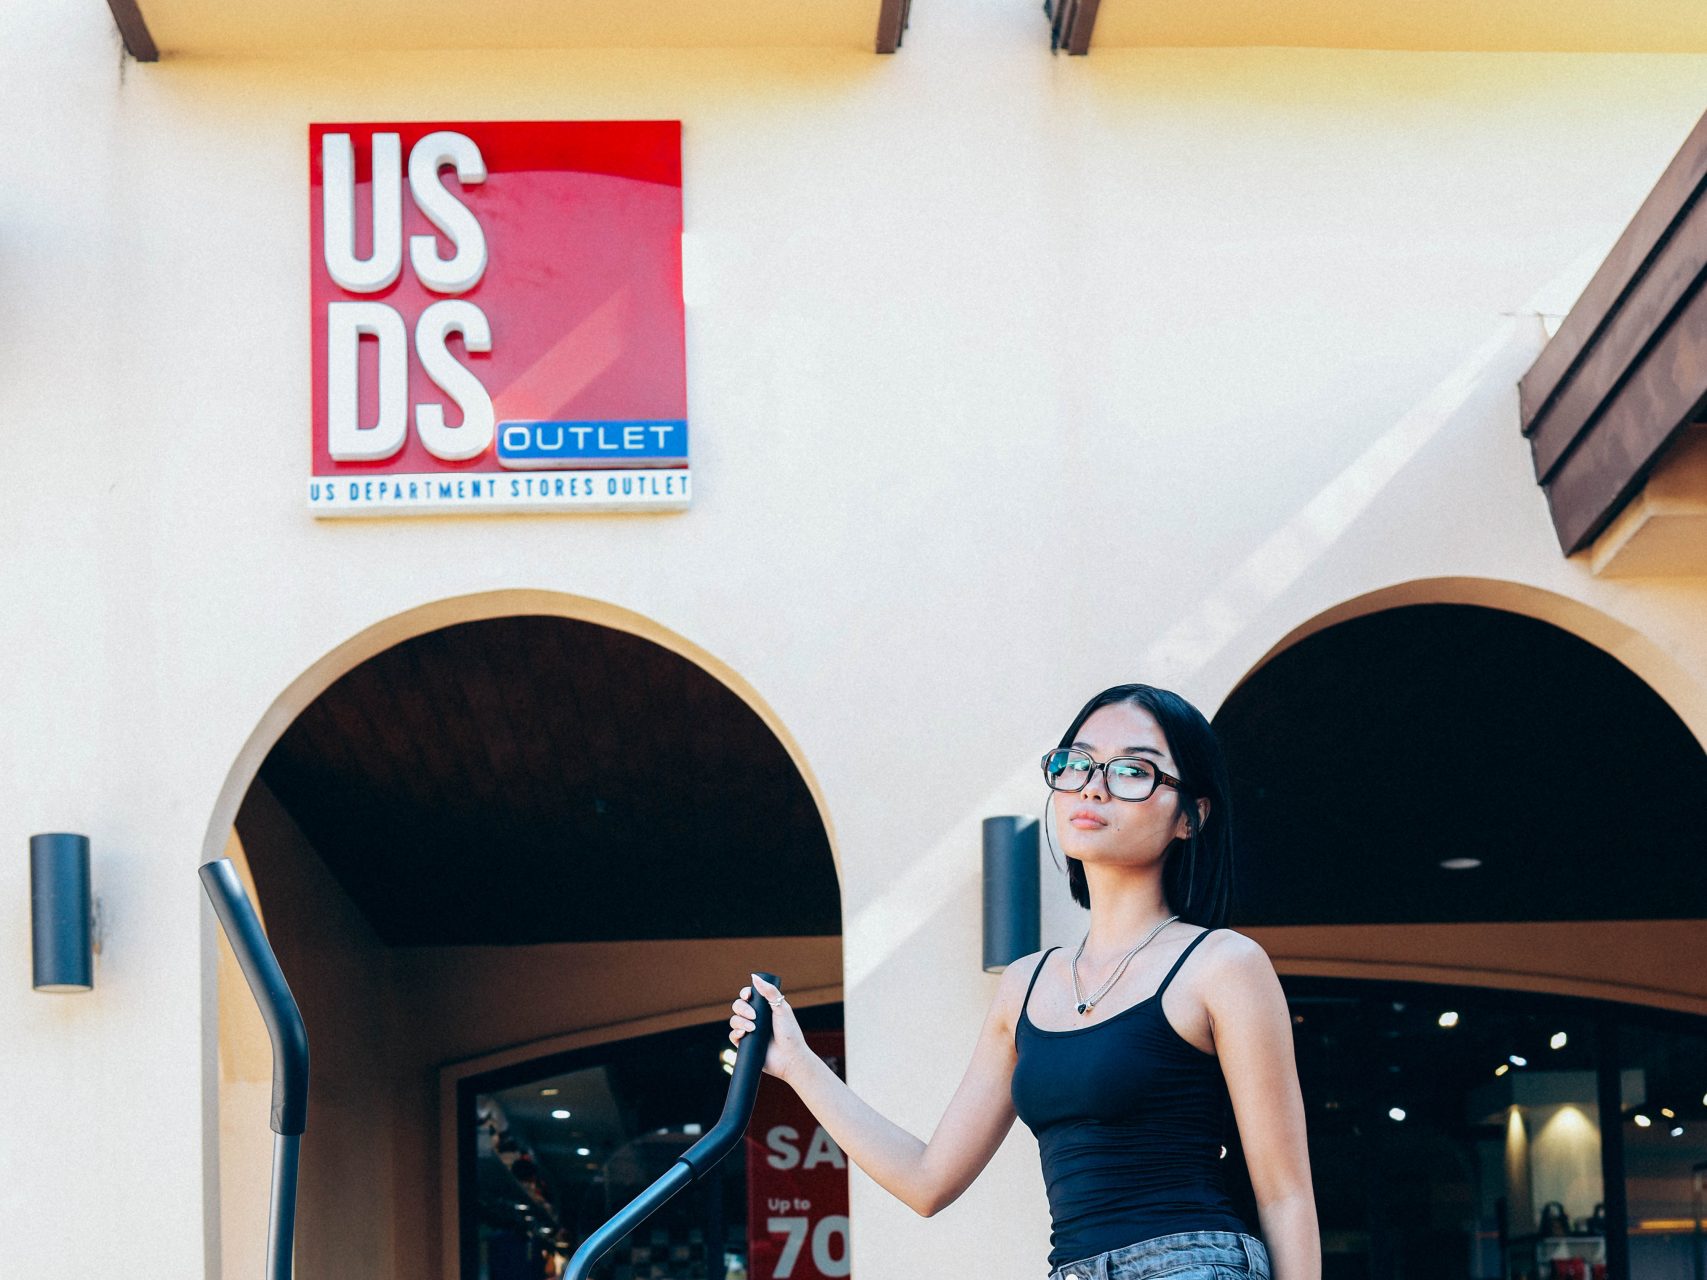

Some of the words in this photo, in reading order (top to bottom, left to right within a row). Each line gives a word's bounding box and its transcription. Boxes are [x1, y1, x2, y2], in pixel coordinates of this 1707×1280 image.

[322, 131, 488, 293] US
[328, 299, 494, 461] DS
[503, 426, 674, 451] OUTLET
[310, 483, 335, 501] US
[350, 479, 497, 501] DEPARTMENT
[511, 477, 594, 498] STORES
[607, 476, 688, 496] OUTLET
[767, 1198, 791, 1214] Up
[794, 1198, 811, 1210] to
[766, 1214, 850, 1279] 70
